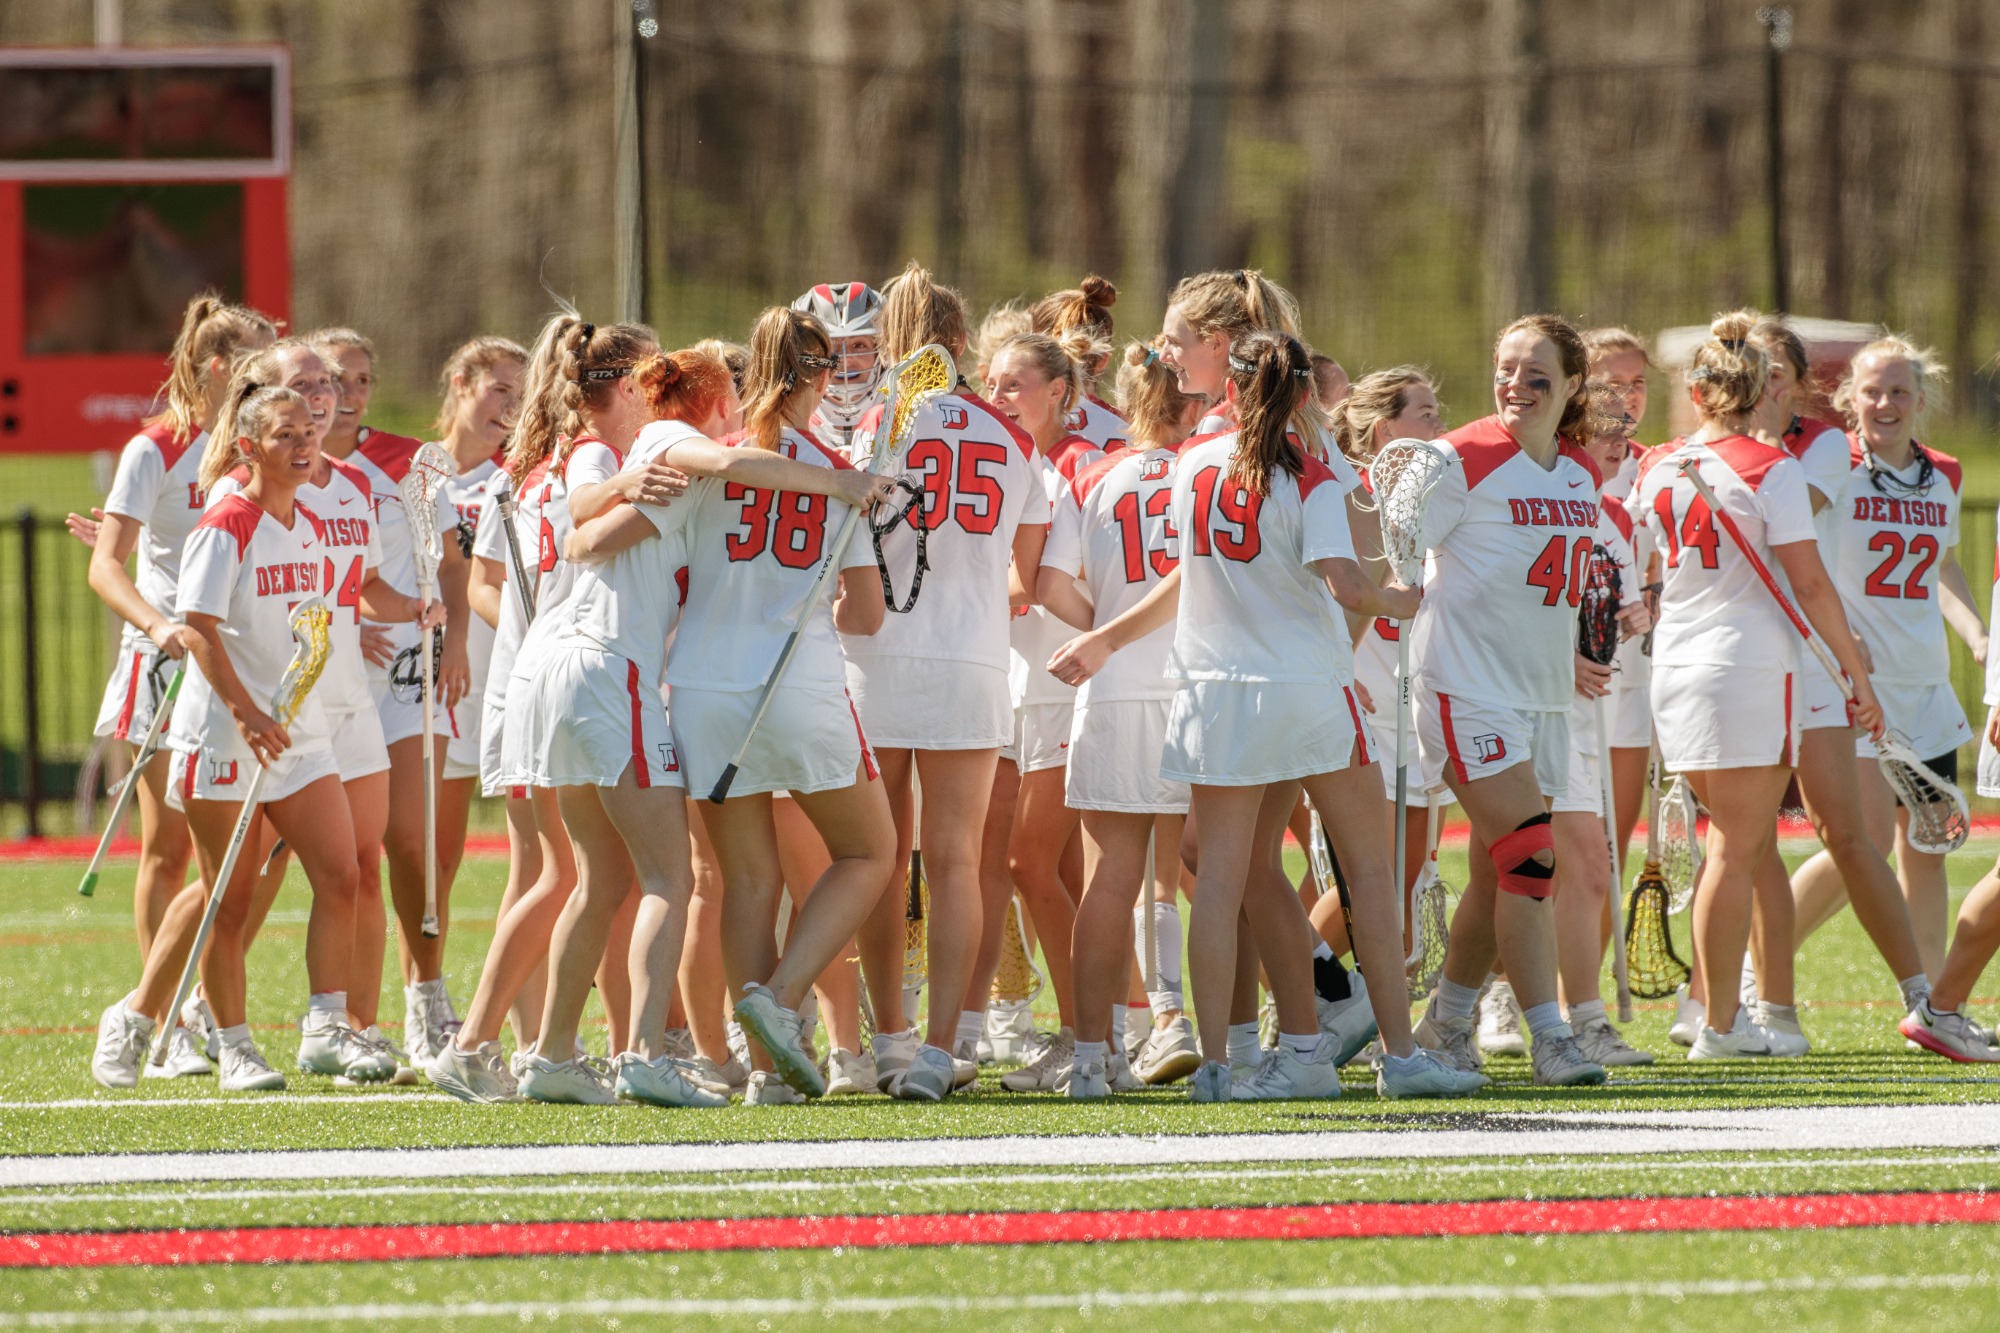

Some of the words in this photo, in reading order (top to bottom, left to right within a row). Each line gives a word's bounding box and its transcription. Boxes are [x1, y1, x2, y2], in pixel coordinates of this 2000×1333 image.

[588, 369, 614, 379] STX
[939, 403, 968, 431] D
[1139, 458, 1168, 482] D
[906, 438, 1007, 536] 35
[724, 480, 828, 570] 38
[1191, 464, 1265, 564] 19
[1508, 497, 1598, 529] DENISO
[1853, 496, 1948, 527] DENISON
[1113, 487, 1180, 584] 13
[1653, 487, 1720, 569] 14
[256, 562, 318, 597] DENISO
[817, 554, 833, 582] GAIT
[913, 564, 925, 590] STX
[1526, 535, 1593, 608] 40
[1865, 530, 1939, 600] 22
[881, 571, 893, 596] STX
[658, 743, 680, 772] D
[1473, 733, 1507, 765] D
[210, 757, 238, 786] D
[234, 815, 249, 843] GAIT
